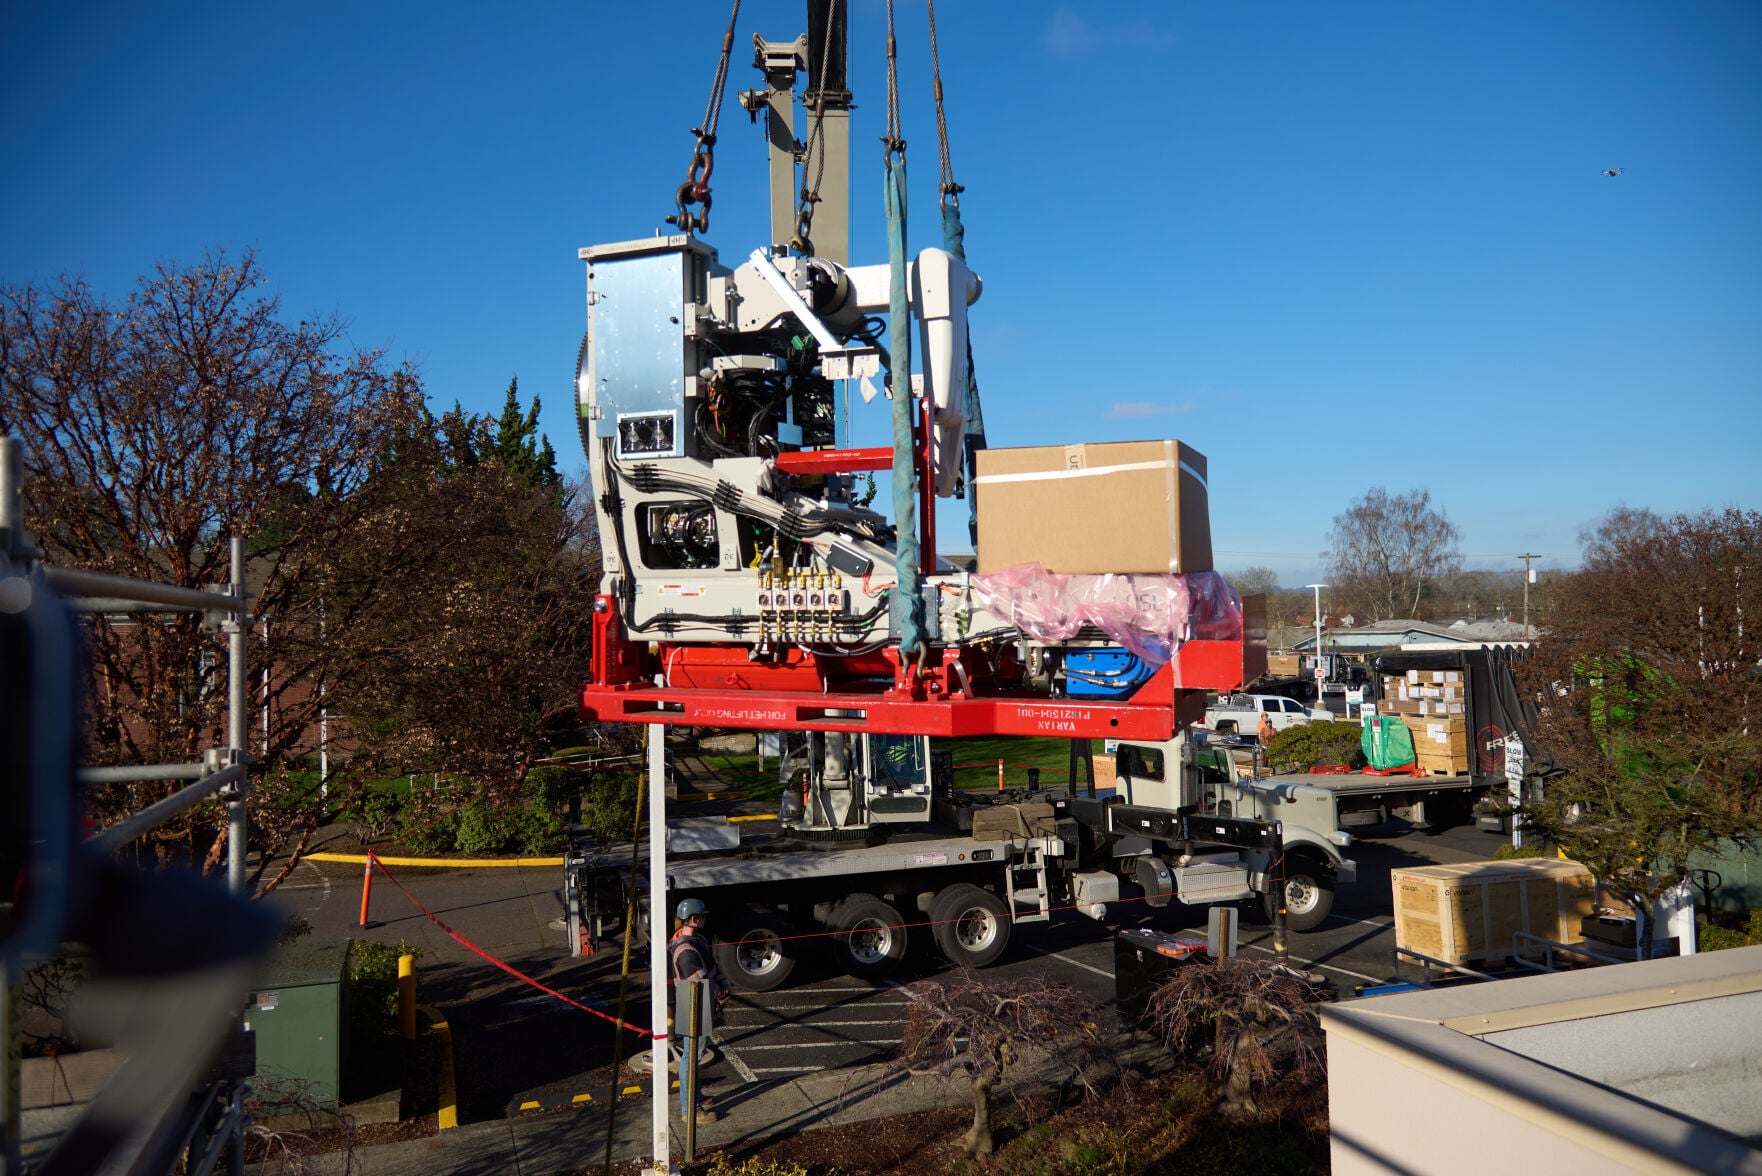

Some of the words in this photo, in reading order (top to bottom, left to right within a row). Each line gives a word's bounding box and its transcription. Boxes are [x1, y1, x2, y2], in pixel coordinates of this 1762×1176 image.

[717, 709, 748, 719] LIFTING
[750, 710, 767, 720] HET
[767, 711, 786, 721] FOR
[1017, 708, 1091, 720] P121504-001
[1037, 720, 1076, 731] VARIAN
[1506, 746, 1522, 756] SLOW
